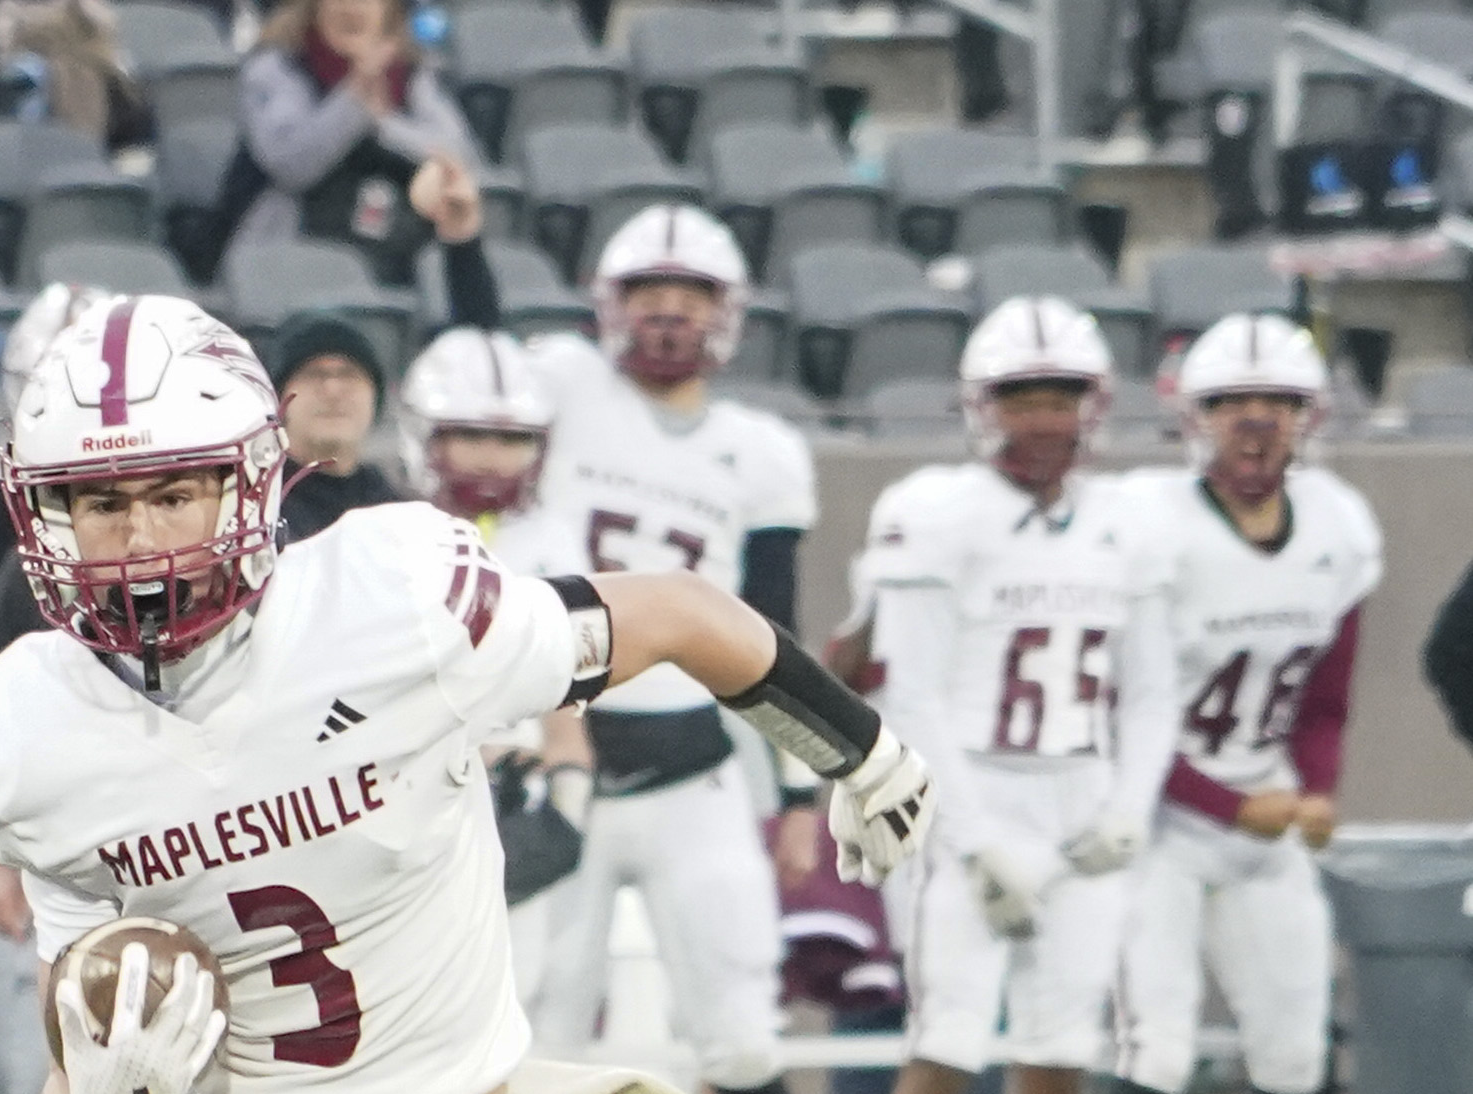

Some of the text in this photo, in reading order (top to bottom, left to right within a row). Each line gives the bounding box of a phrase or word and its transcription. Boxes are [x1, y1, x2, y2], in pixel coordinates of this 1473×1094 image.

[81, 429, 152, 452] Riddell
[98, 762, 385, 887] MAPLESVILLE
[227, 885, 363, 1068] 3
